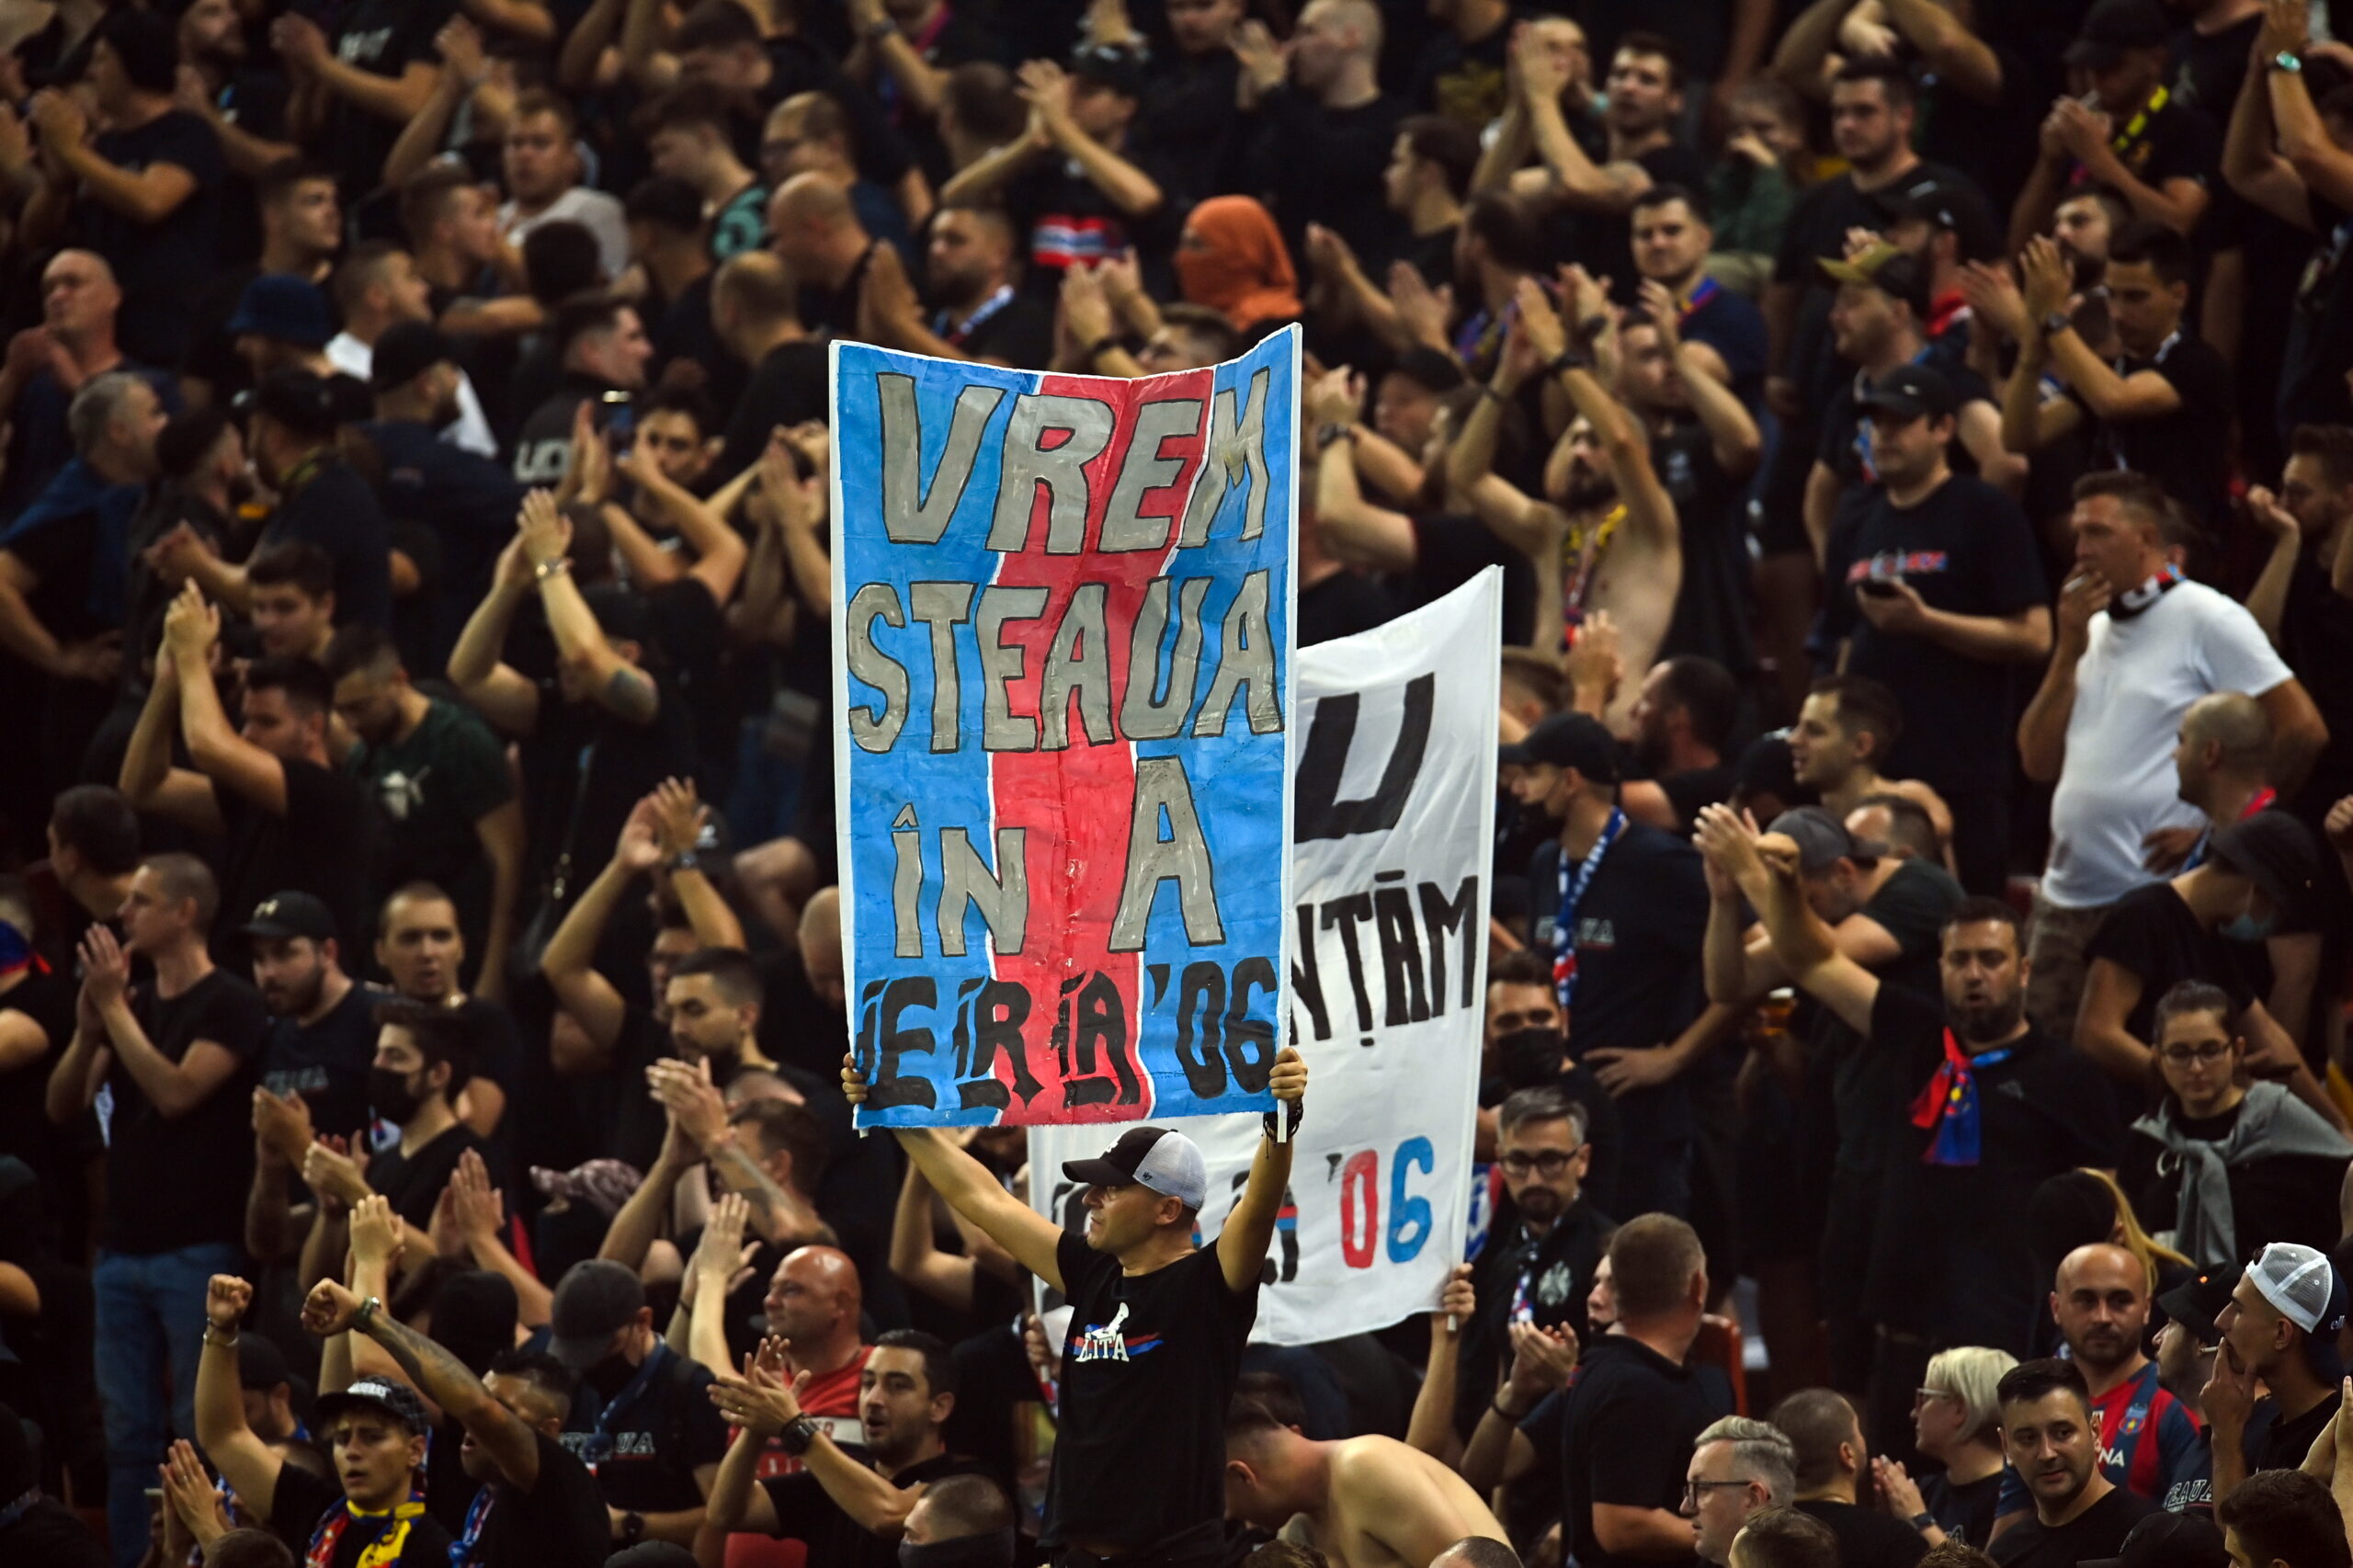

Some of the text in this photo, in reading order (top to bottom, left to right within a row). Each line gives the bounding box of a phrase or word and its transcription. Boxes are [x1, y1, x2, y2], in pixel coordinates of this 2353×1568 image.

[876, 366, 1270, 556] VREM
[847, 569, 1285, 754] STEAUA
[892, 755, 1225, 958] ÎN A
